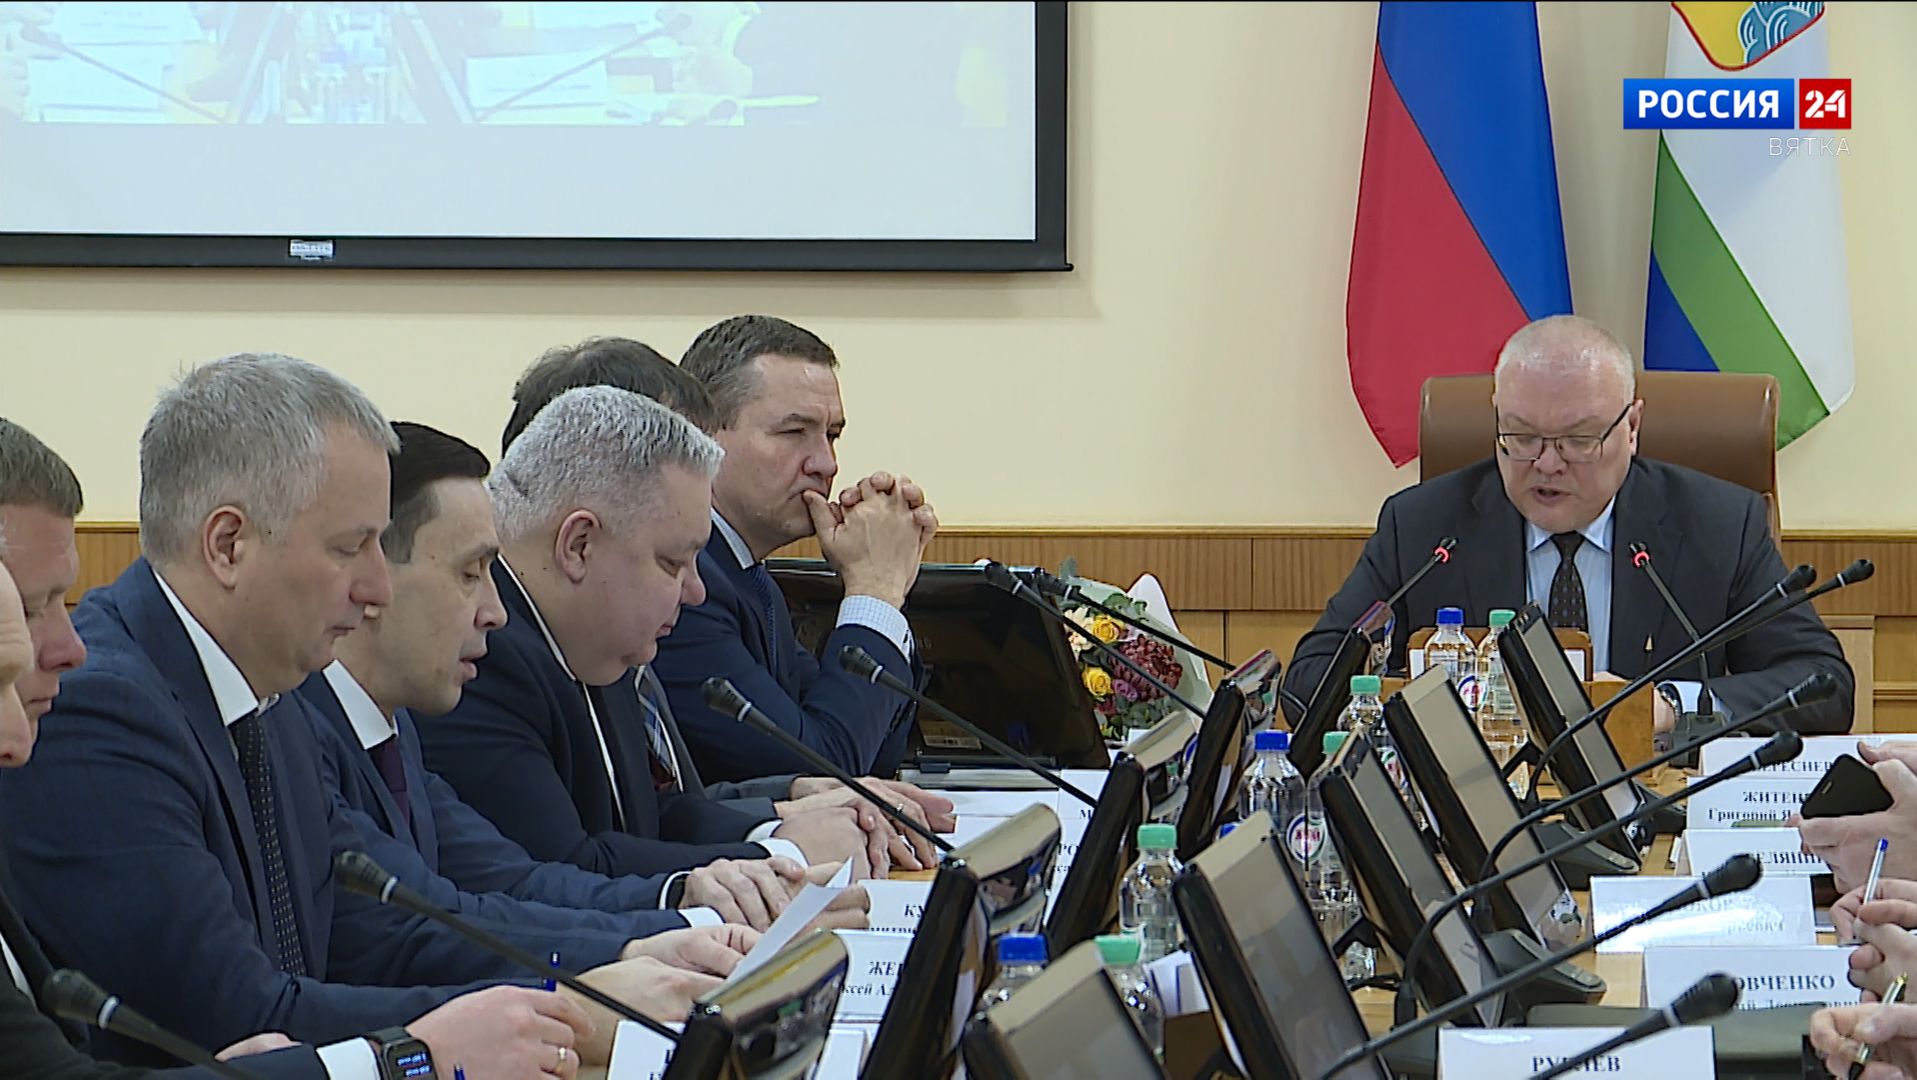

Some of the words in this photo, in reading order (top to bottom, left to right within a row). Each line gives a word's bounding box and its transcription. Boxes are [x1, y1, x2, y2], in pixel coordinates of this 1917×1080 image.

[1743, 791, 1809, 804] ЖИТЕН
[1737, 975, 1835, 990] ОВЧЕНКО
[1532, 1055, 1621, 1072] РУЛЕВ
